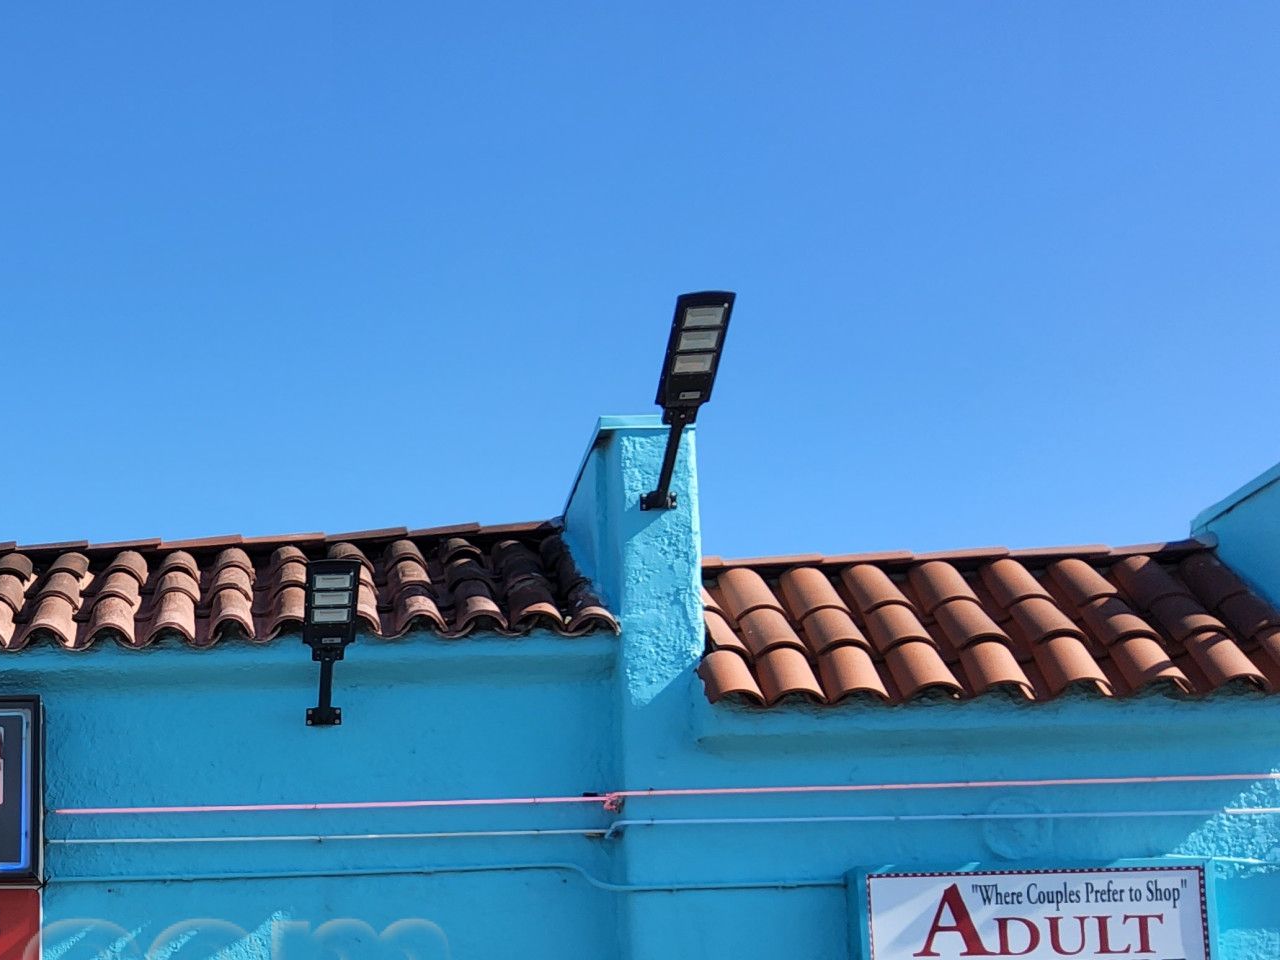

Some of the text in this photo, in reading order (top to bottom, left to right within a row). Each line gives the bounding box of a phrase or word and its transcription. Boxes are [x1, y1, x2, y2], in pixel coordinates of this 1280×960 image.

[913, 882, 1164, 957] ADULT
[1026, 881, 1081, 911] Couples
[1085, 881, 1124, 903] Prefer
[1128, 884, 1142, 902] to
